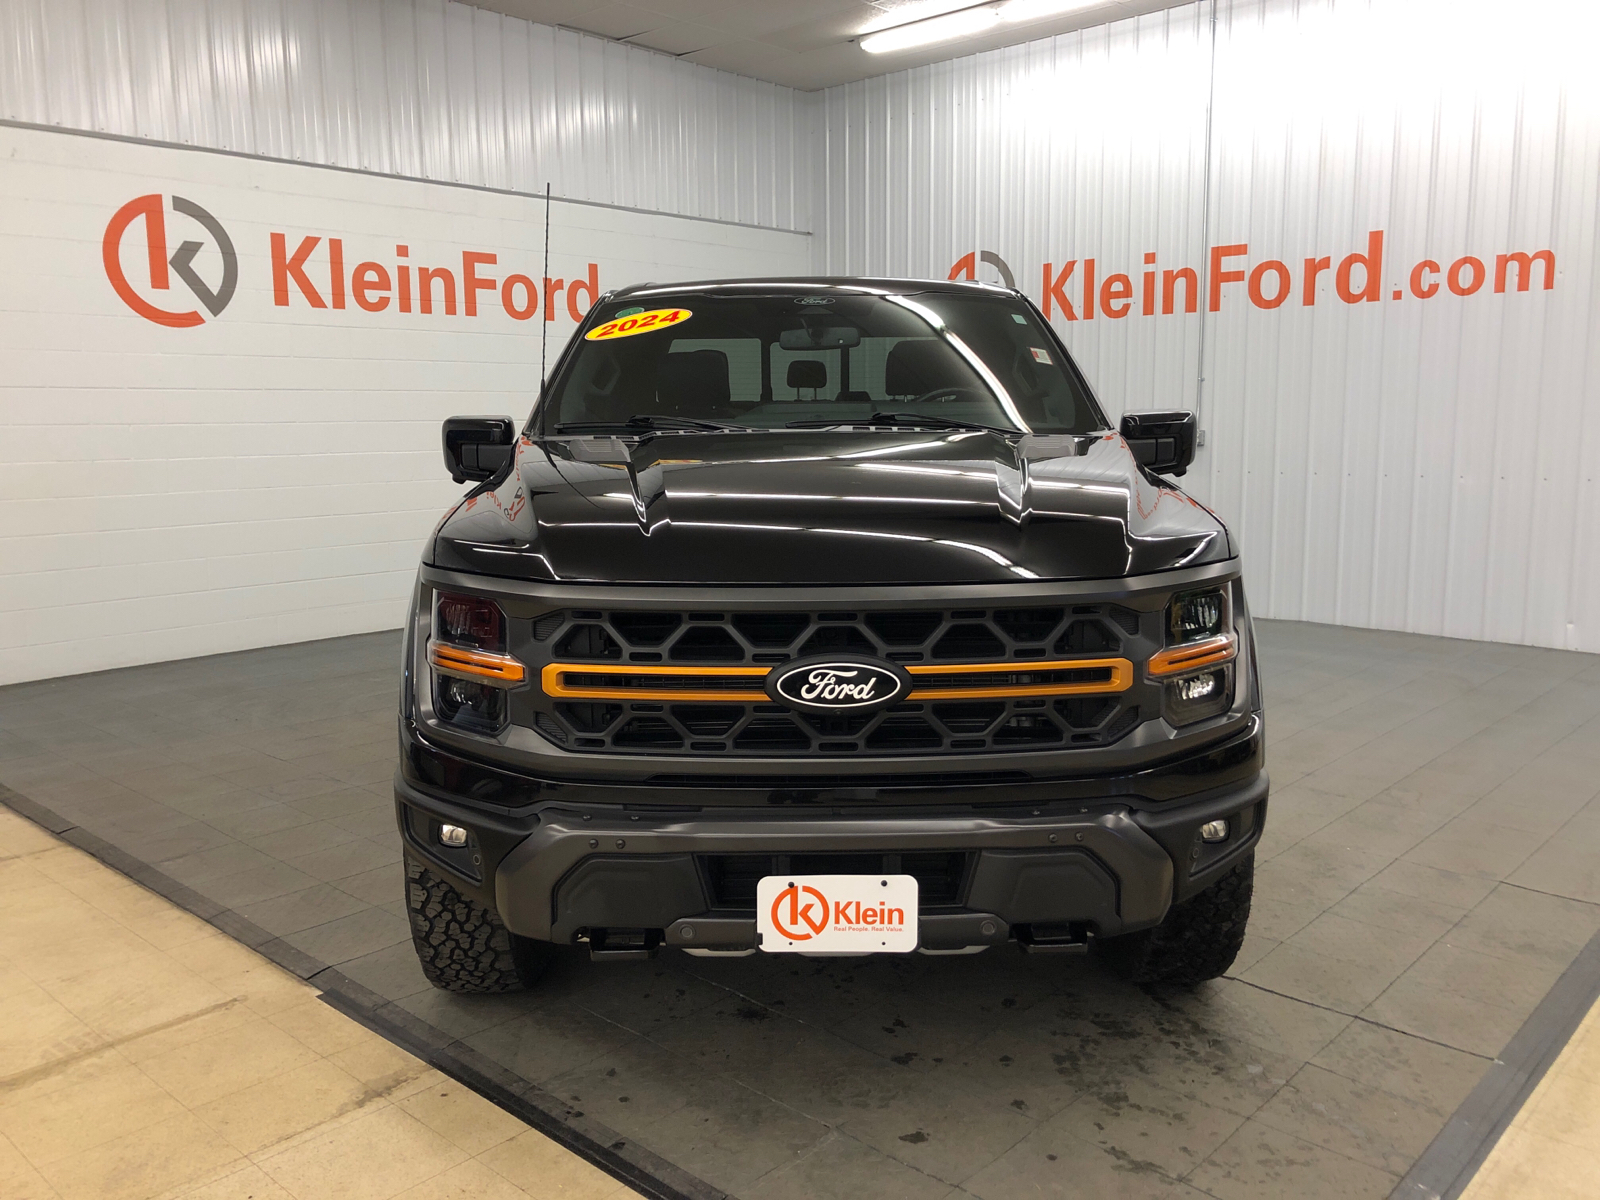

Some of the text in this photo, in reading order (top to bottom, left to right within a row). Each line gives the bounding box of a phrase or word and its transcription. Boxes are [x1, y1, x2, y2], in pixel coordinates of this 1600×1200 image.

[270, 232, 600, 324] KleinFord
[1042, 230, 1556, 321] KleinFord.com
[596, 310, 681, 338] 2024
[800, 669, 877, 700] Ford
[834, 901, 904, 925] Klein
